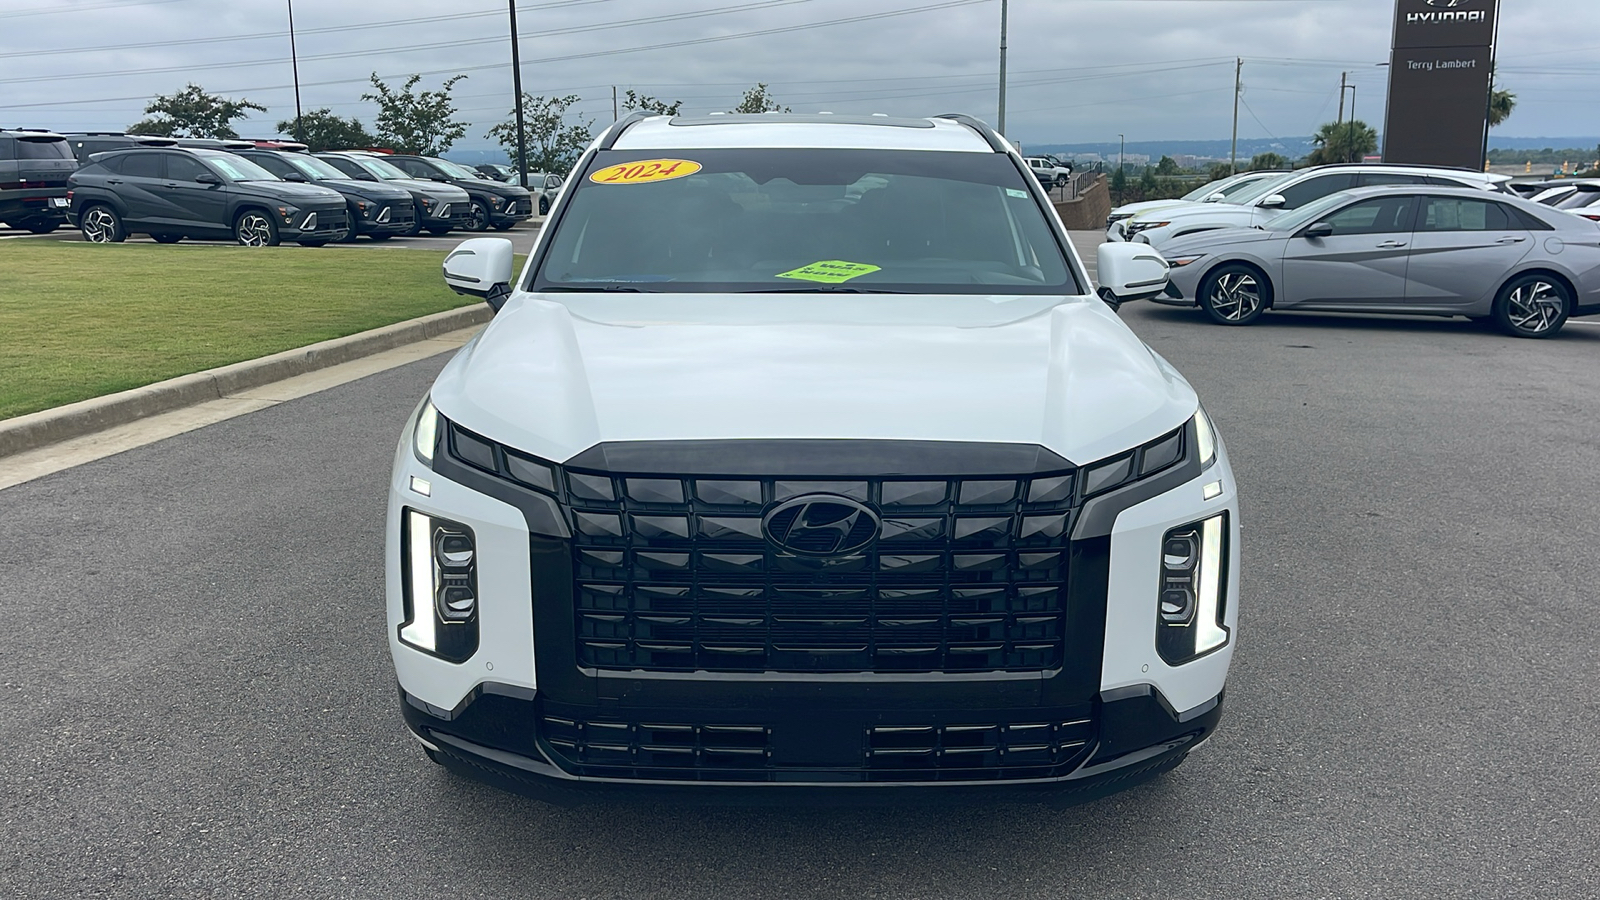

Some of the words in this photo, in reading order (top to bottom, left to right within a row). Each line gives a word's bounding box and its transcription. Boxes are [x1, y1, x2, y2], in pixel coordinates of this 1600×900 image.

[1406, 10, 1485, 25] HYUNDAI
[1407, 60, 1433, 71] Terry
[1435, 59, 1476, 69] Lambert
[603, 161, 683, 182] 2024
